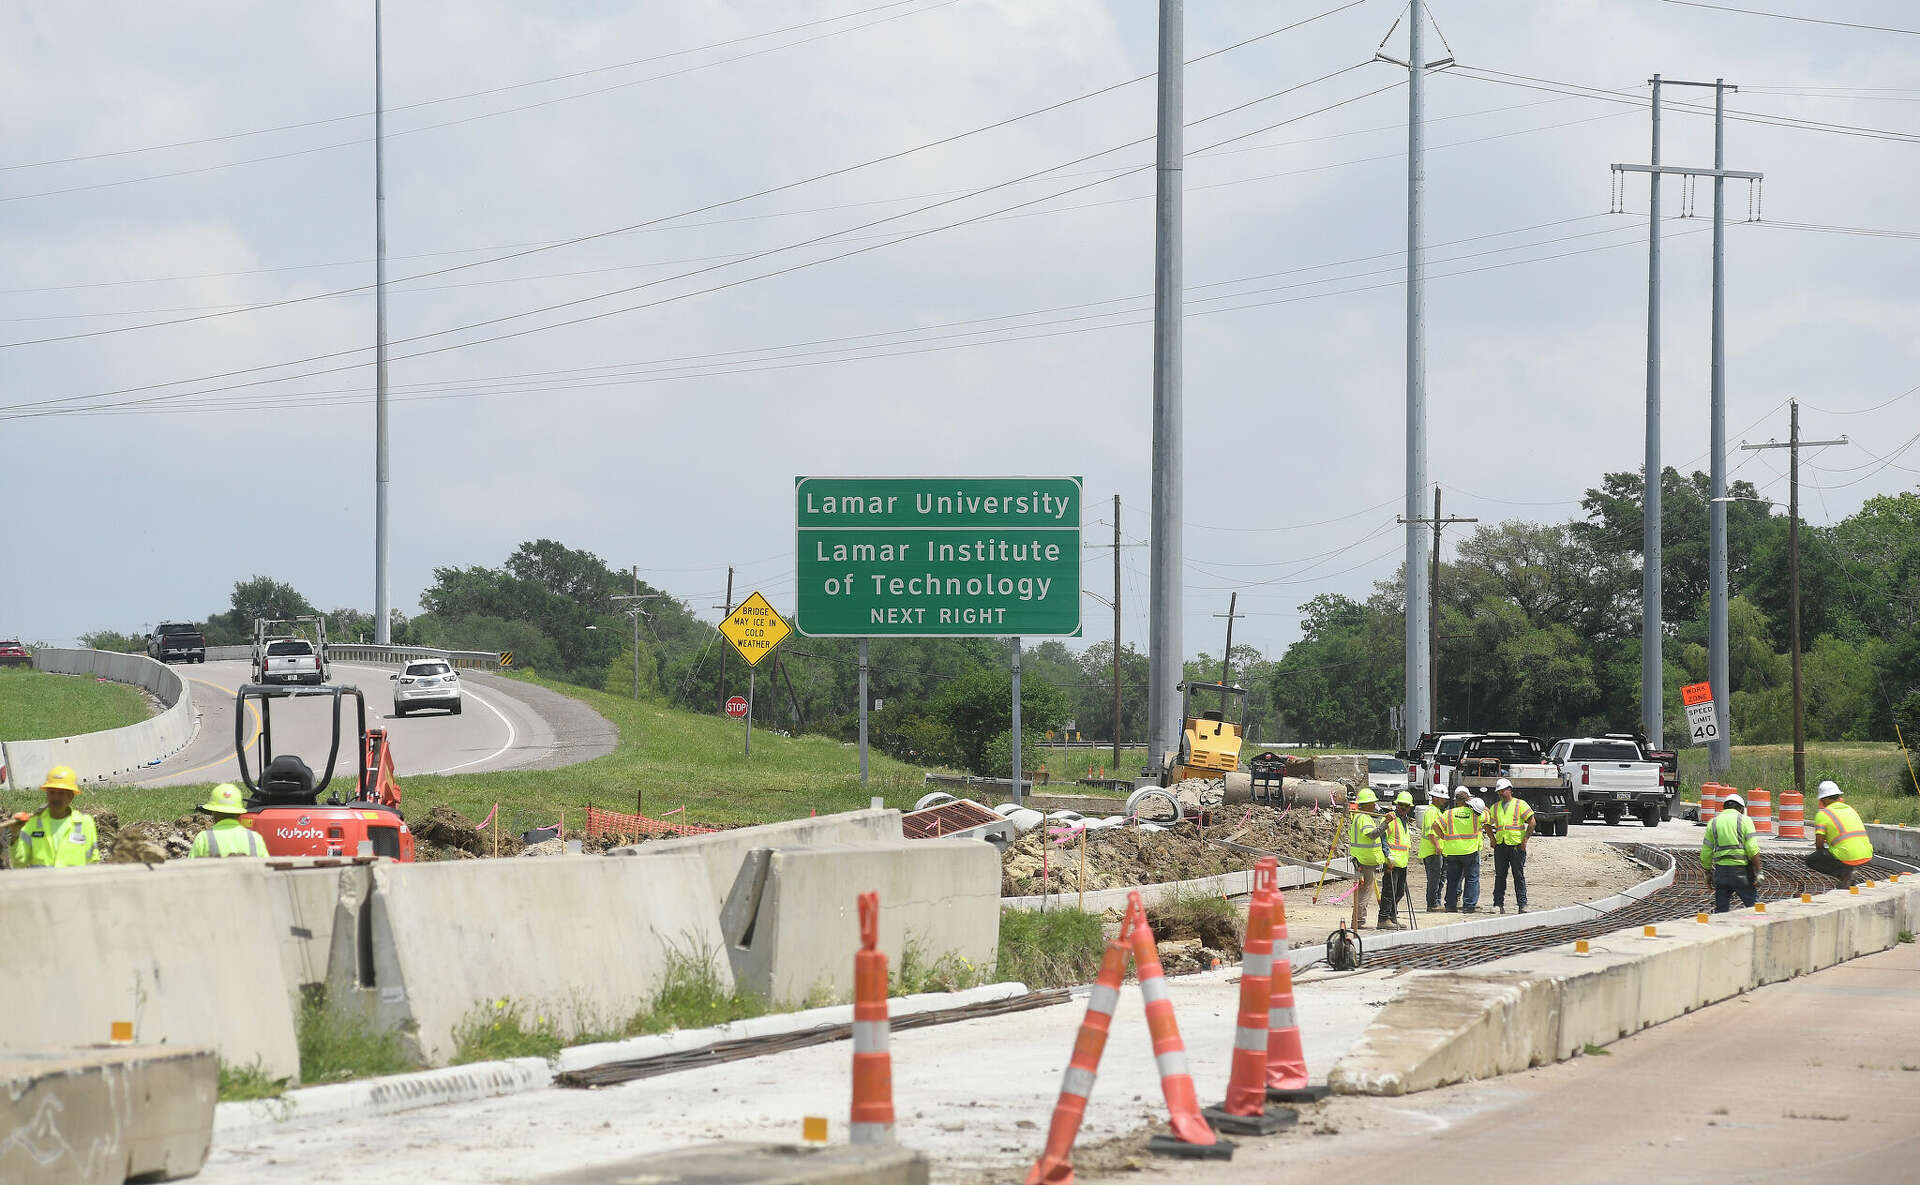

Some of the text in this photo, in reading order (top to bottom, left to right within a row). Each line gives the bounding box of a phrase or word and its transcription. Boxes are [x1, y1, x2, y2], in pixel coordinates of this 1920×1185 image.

[806, 491, 1070, 519] Lamar University
[817, 538, 1060, 562] Lamar Institute
[824, 573, 1052, 600] of Technology
[742, 606, 768, 616] BRIDGE
[870, 608, 1007, 624] NEXT RIGHT
[734, 617, 776, 627] MAY ICE IN
[745, 629, 764, 637] COLD
[737, 640, 770, 648] WEATHER
[1686, 686, 1706, 695] WORK
[1688, 694, 1707, 702] ZONE
[727, 702, 746, 712] STOP
[1688, 707, 1713, 716] SPEED
[1693, 716, 1712, 724] LIMIT
[1694, 724, 1716, 738] 40
[277, 827, 325, 840] Kubota
